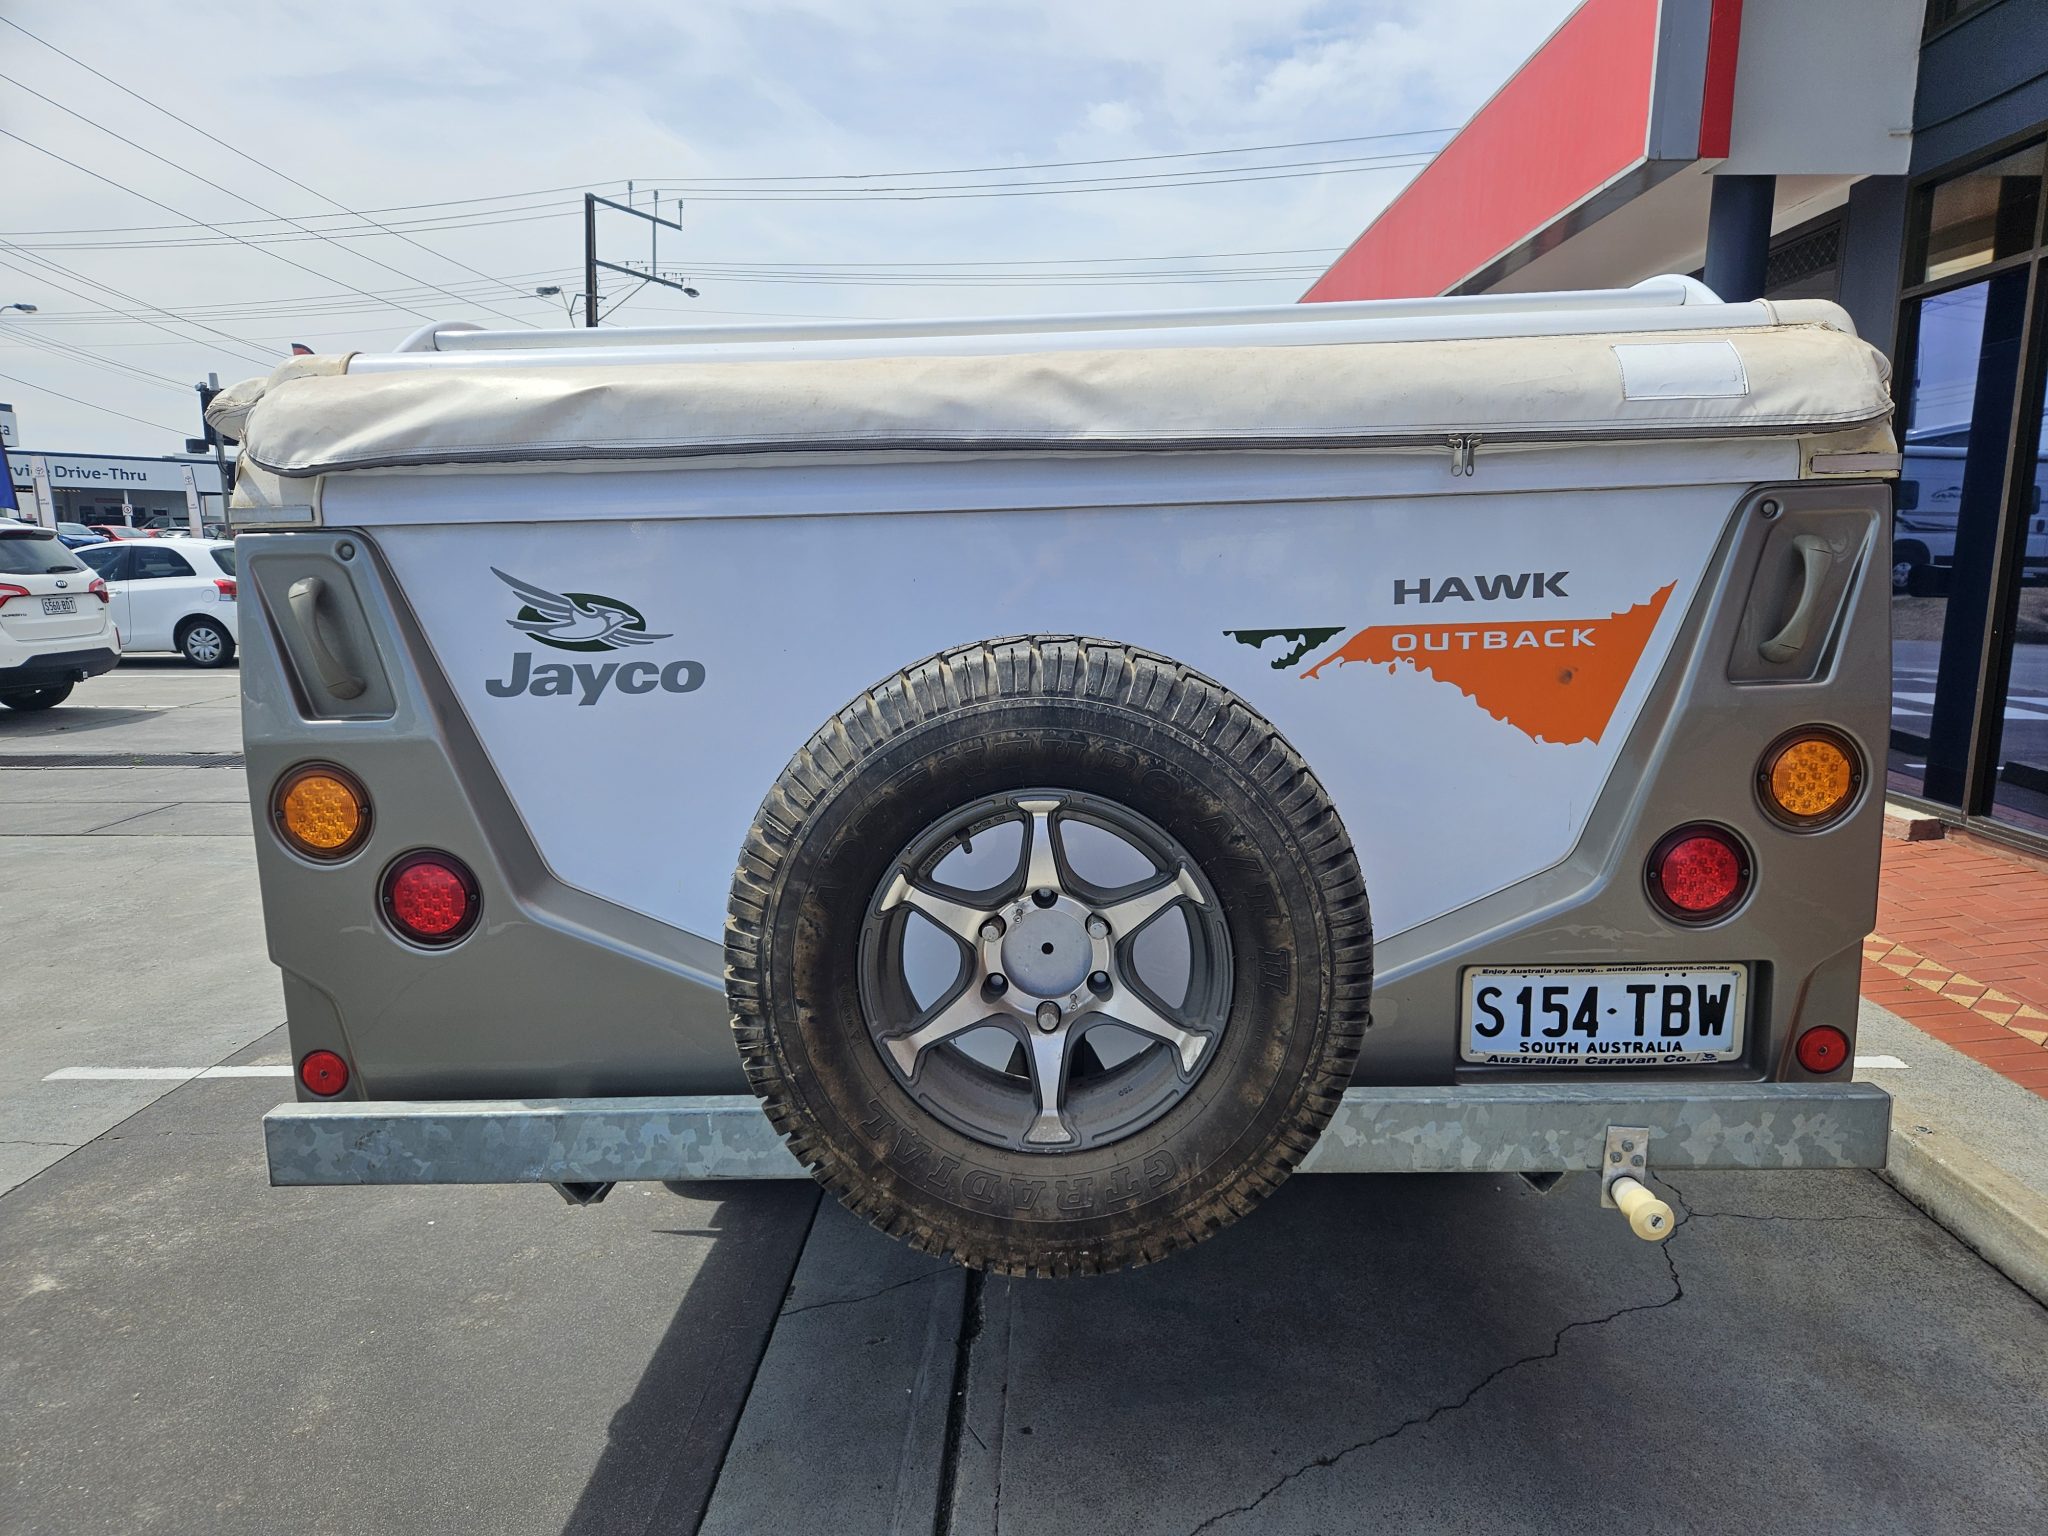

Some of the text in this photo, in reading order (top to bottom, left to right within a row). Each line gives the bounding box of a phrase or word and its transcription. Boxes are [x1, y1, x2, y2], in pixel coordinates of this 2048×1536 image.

[54, 465, 147, 481] Drive-Thru
[1393, 571, 1570, 605] HAWK
[1391, 628, 1597, 652] OUTBACK
[485, 652, 706, 707] Jayco
[1519, 1041, 1683, 1054] SOUTH AUSTRALIA
[1486, 1054, 1579, 1065] Australian
[1585, 1056, 1657, 1065] Caravan
[1663, 1054, 1691, 1063] Co.
